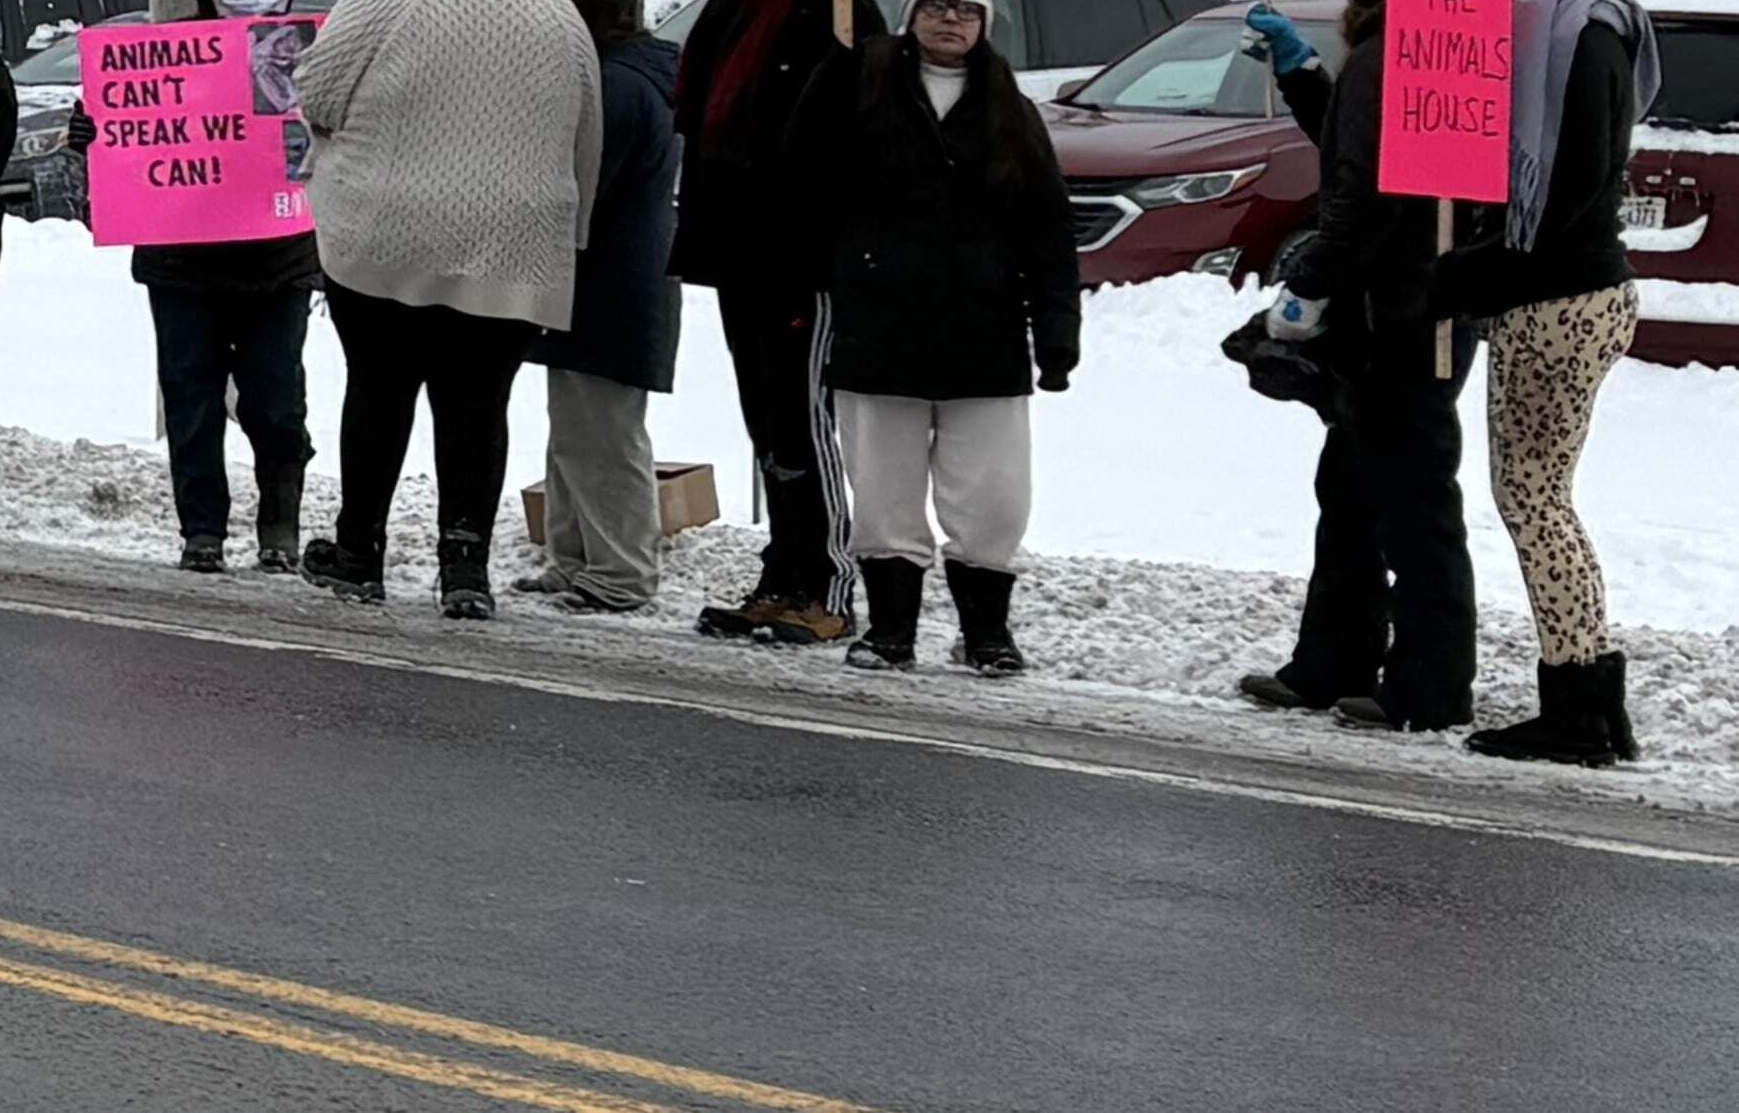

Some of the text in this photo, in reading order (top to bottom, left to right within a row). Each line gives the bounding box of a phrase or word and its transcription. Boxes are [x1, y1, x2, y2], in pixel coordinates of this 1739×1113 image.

[101, 37, 223, 72] ANIMALS
[1397, 28, 1509, 80] ANIMALS
[102, 74, 185, 109] CAN'T
[1403, 86, 1499, 137] HOUSE
[104, 114, 246, 148] SPEAK WE
[148, 156, 222, 187] CAN!
